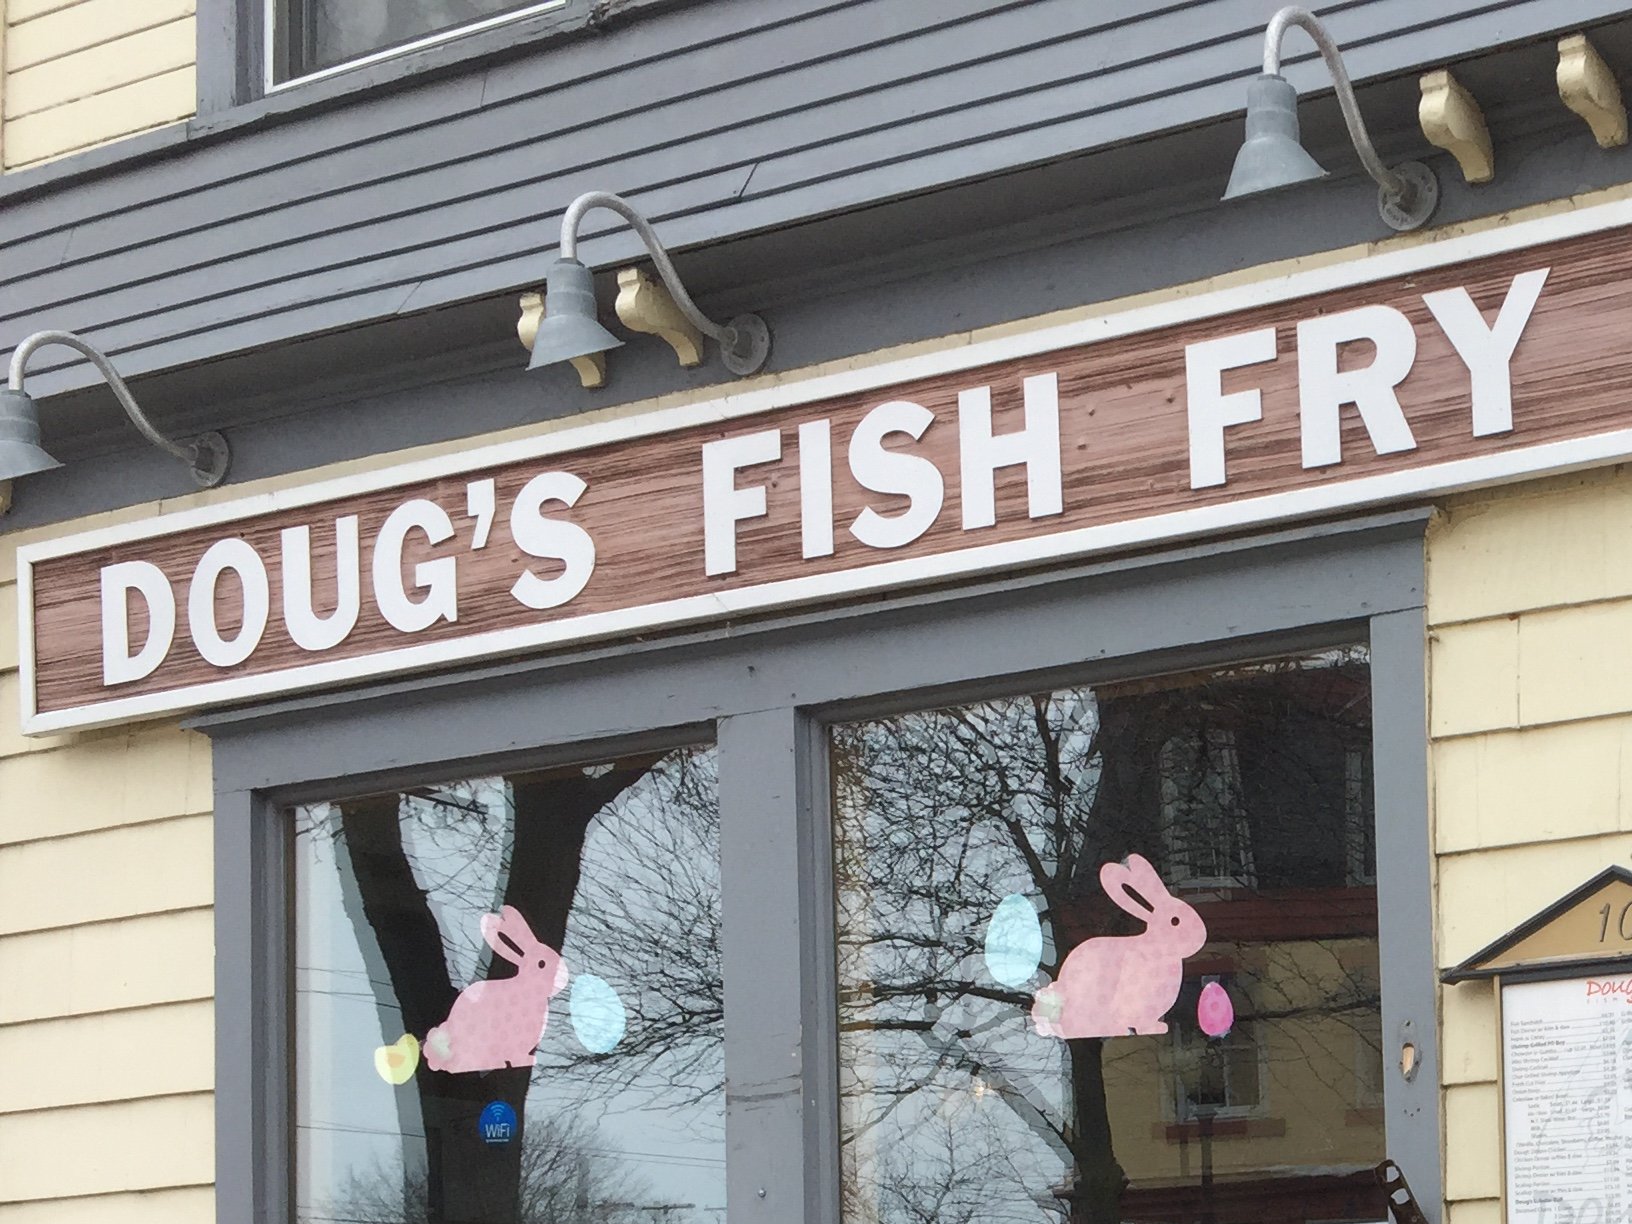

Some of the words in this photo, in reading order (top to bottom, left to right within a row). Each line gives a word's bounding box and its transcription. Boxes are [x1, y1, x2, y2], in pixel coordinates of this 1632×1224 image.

[101, 471, 596, 686] DOUG'S
[702, 371, 1063, 577] FISH
[1184, 266, 1551, 490] FRY
[485, 1123, 510, 1138] WiFi
